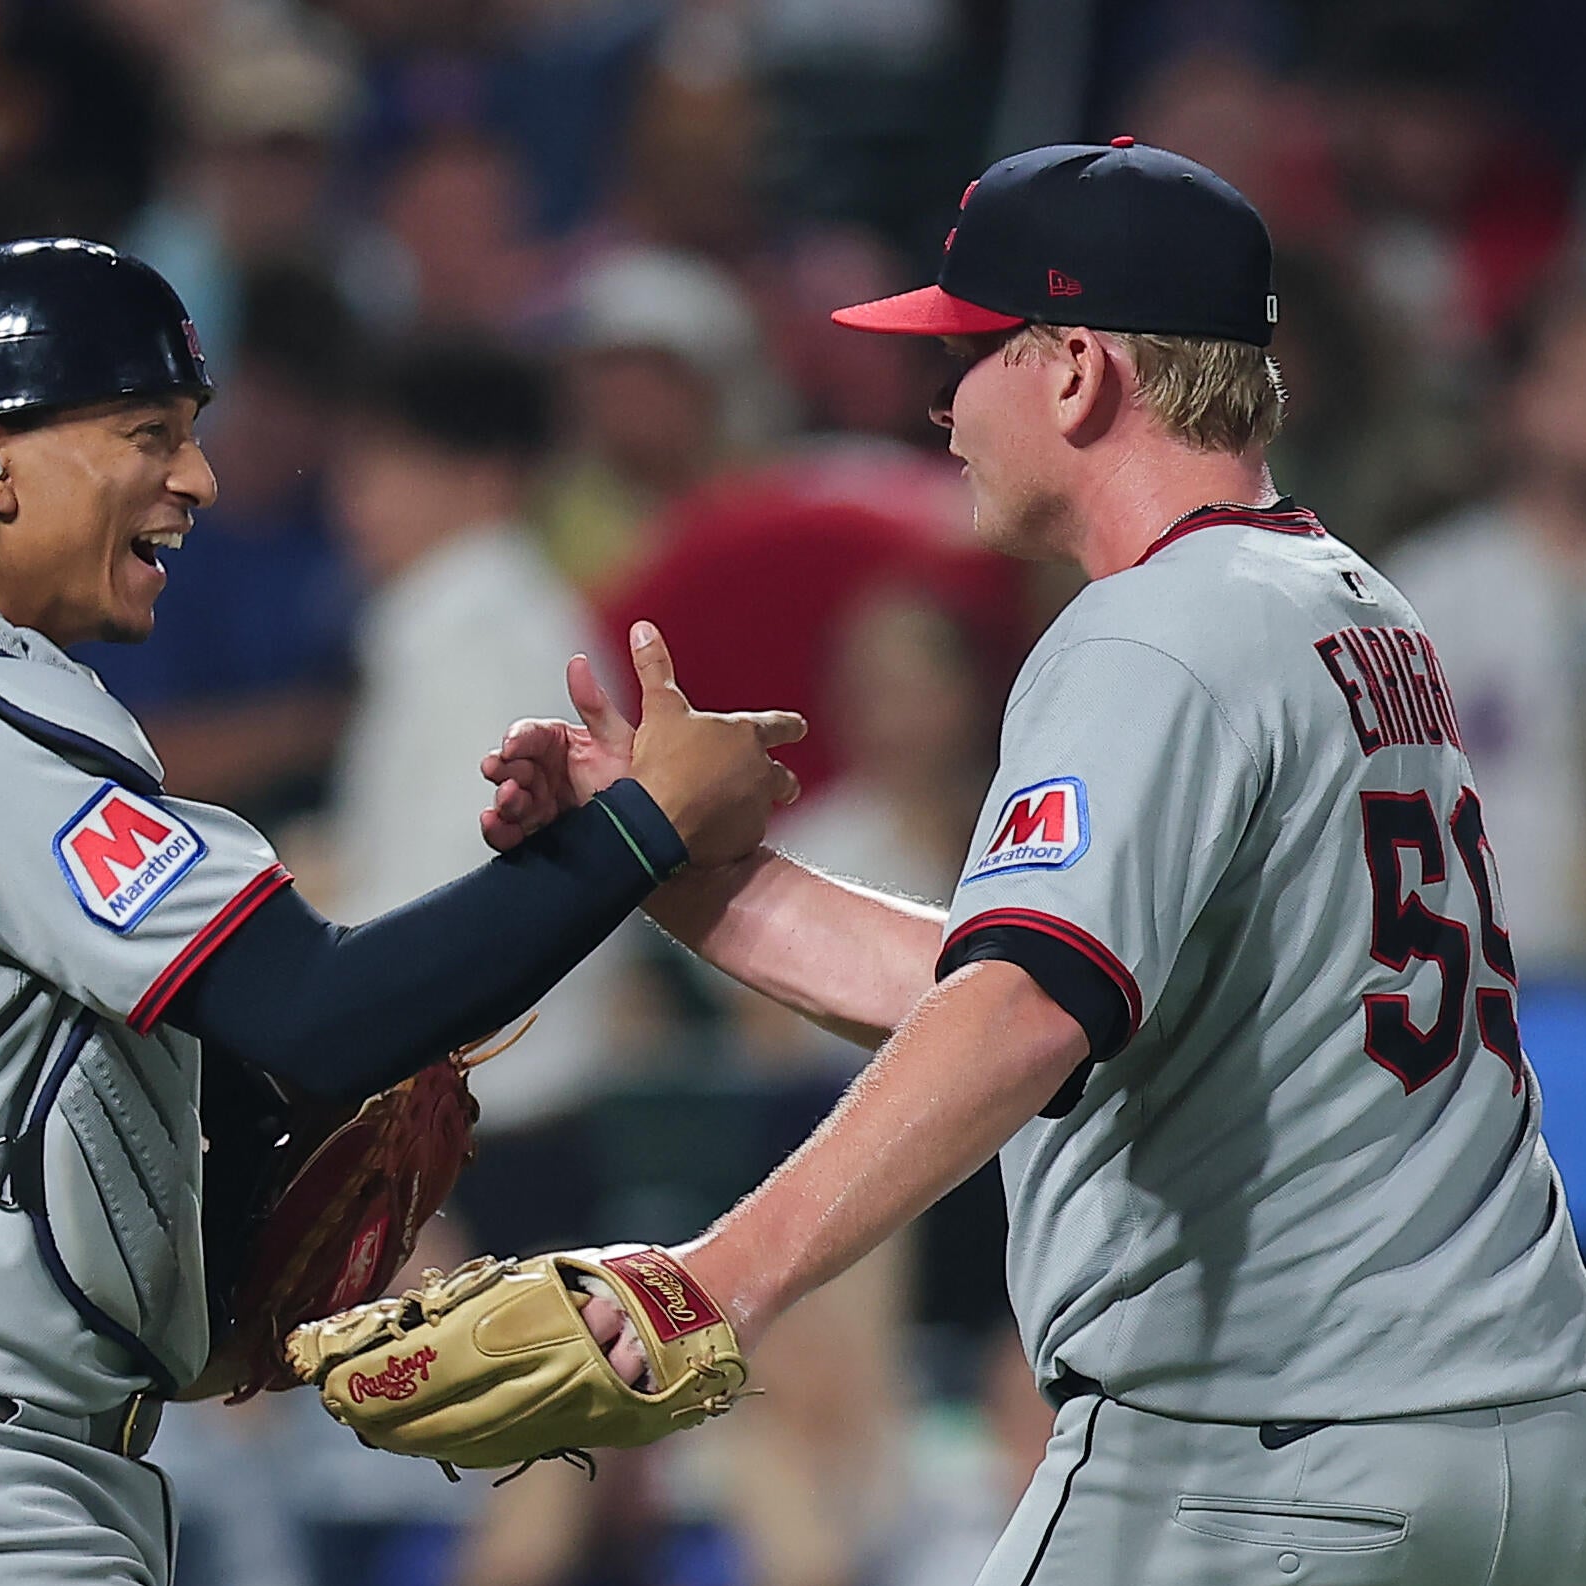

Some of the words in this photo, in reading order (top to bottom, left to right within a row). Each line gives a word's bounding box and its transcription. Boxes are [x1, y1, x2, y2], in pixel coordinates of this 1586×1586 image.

[70, 796, 173, 900] M
[986, 790, 1065, 857] M
[107, 834, 191, 918] Marathon
[977, 844, 1063, 871] Marathon
[348, 1345, 437, 1404] Rawlings
